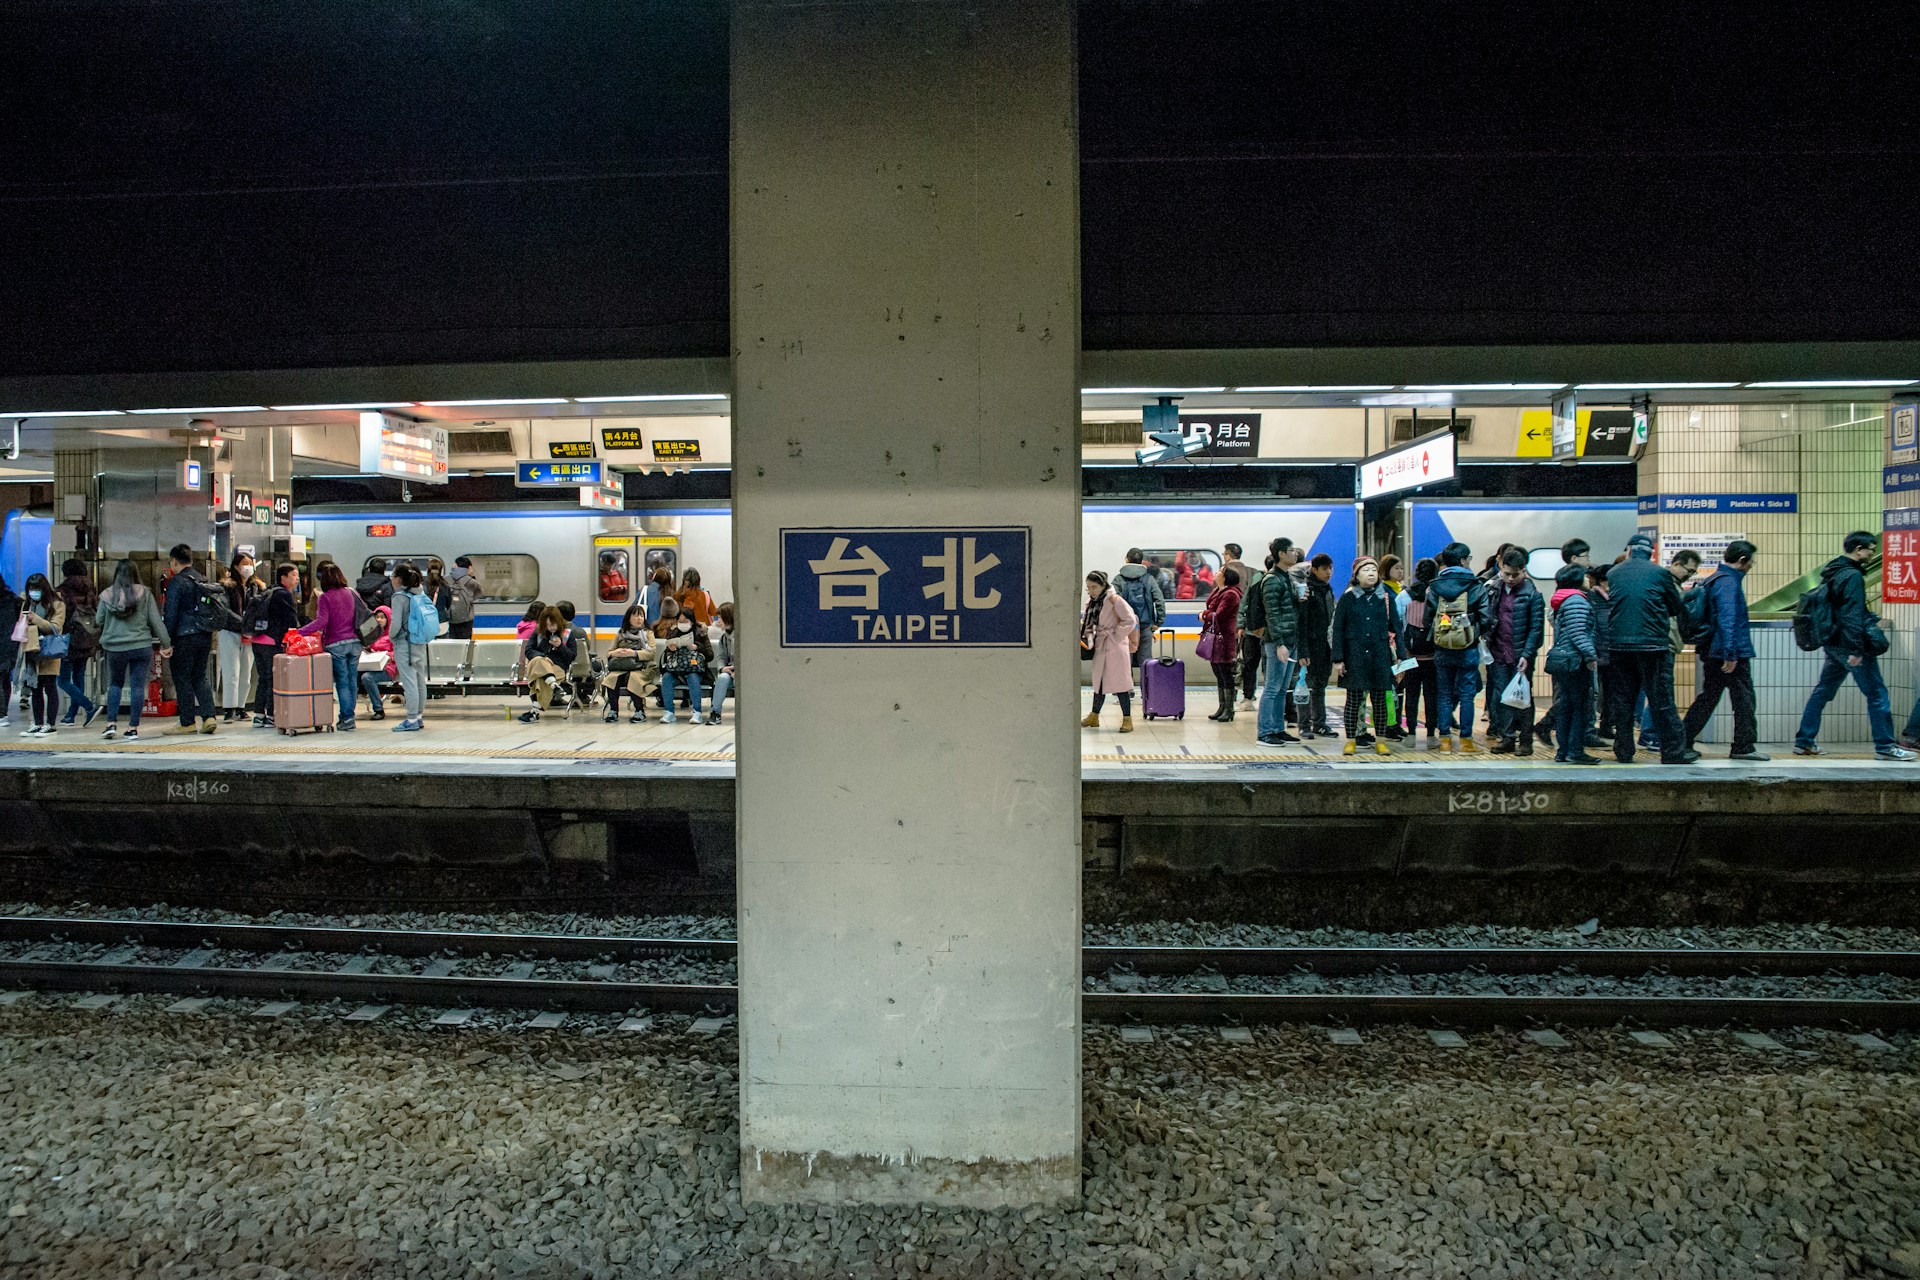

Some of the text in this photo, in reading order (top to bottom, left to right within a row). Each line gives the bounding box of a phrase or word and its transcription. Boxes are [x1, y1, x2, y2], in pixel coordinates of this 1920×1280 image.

[604, 432, 638, 441] 第4月台
[1217, 423, 1251, 439] 月台
[654, 442, 687, 450] 東區出口
[1216, 440, 1251, 448] Platform
[550, 464, 591, 475] 西區出口
[235, 493, 251, 511] 4A
[274, 497, 289, 514] 4B
[1666, 499, 1717, 509] 第4月台B側
[1886, 511, 1919, 527] 進站專用
[1887, 533, 1918, 558] 禁止
[807, 536, 1002, 611] 台北
[1887, 561, 1918, 585] 進入
[1887, 588, 1918, 600] No Entry
[851, 614, 961, 641] TAIPEI
